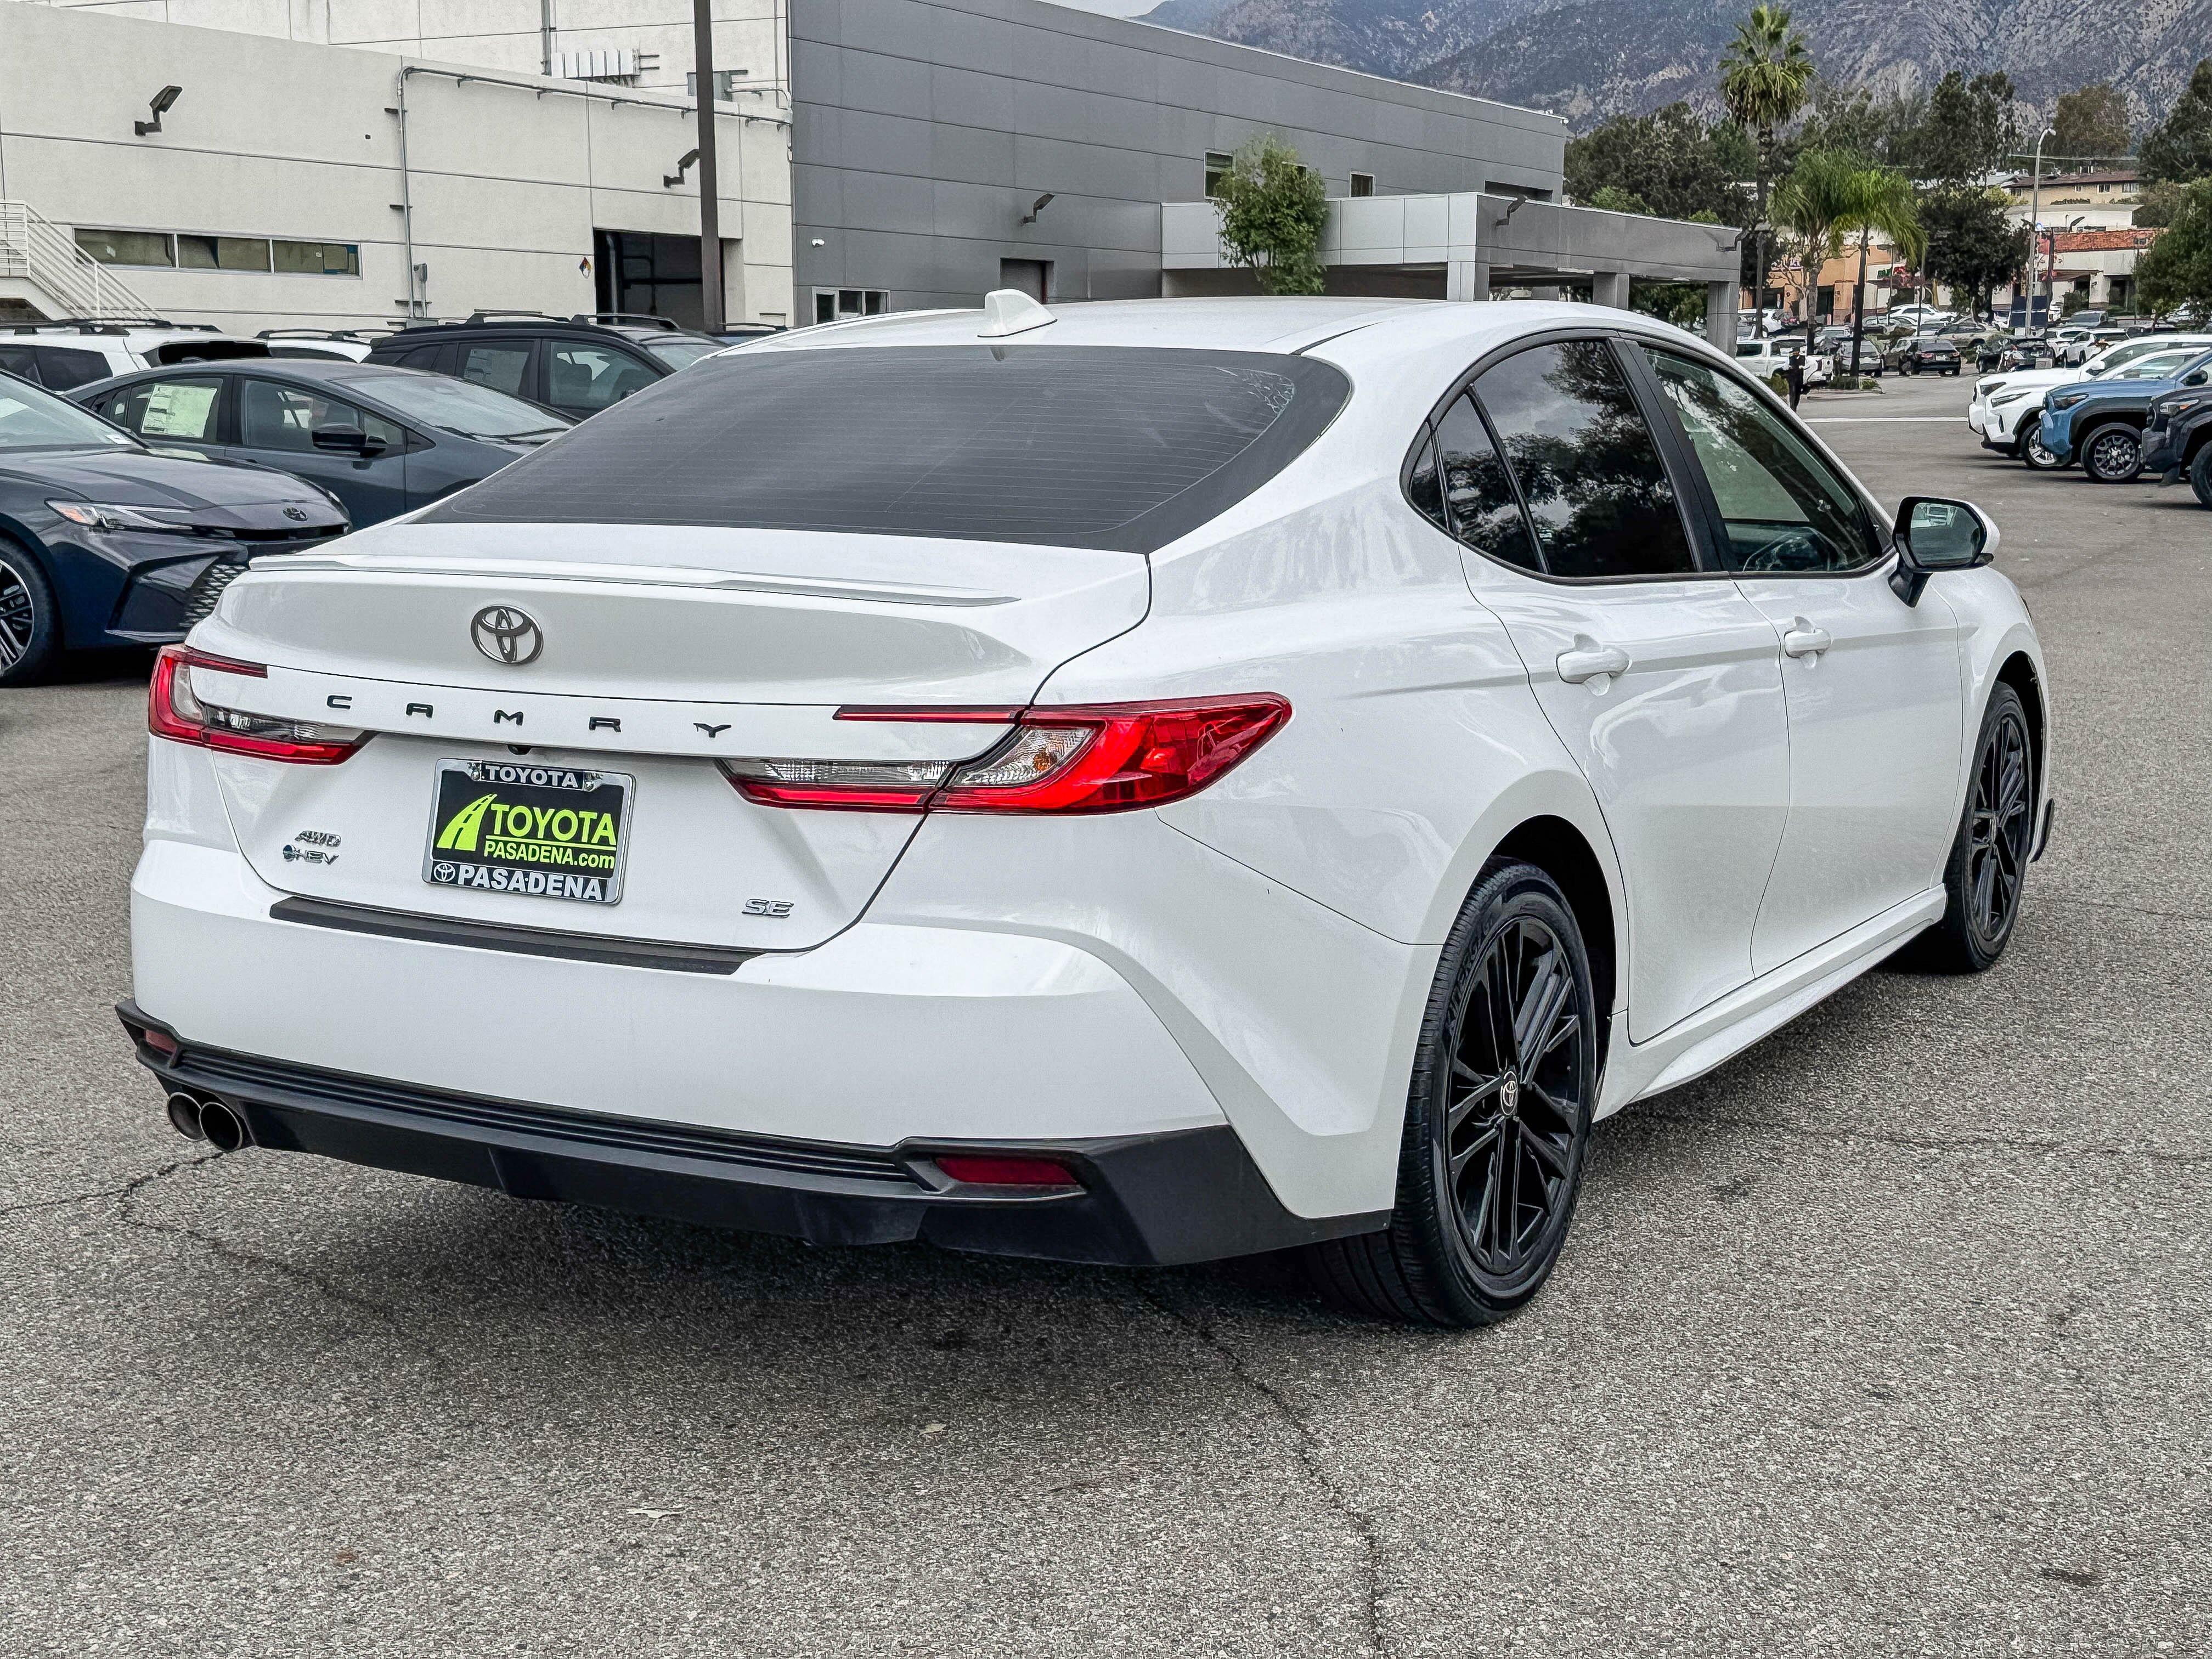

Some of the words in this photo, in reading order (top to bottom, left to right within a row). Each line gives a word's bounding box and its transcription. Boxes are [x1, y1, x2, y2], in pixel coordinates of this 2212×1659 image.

[326, 695, 732, 738] CAMRY
[485, 765, 578, 788] TOYOTA
[490, 803, 616, 845] TOYOTA
[484, 840, 615, 870] PASADENA.com
[458, 865, 603, 901] PASADENA
[741, 899, 794, 918] SE
